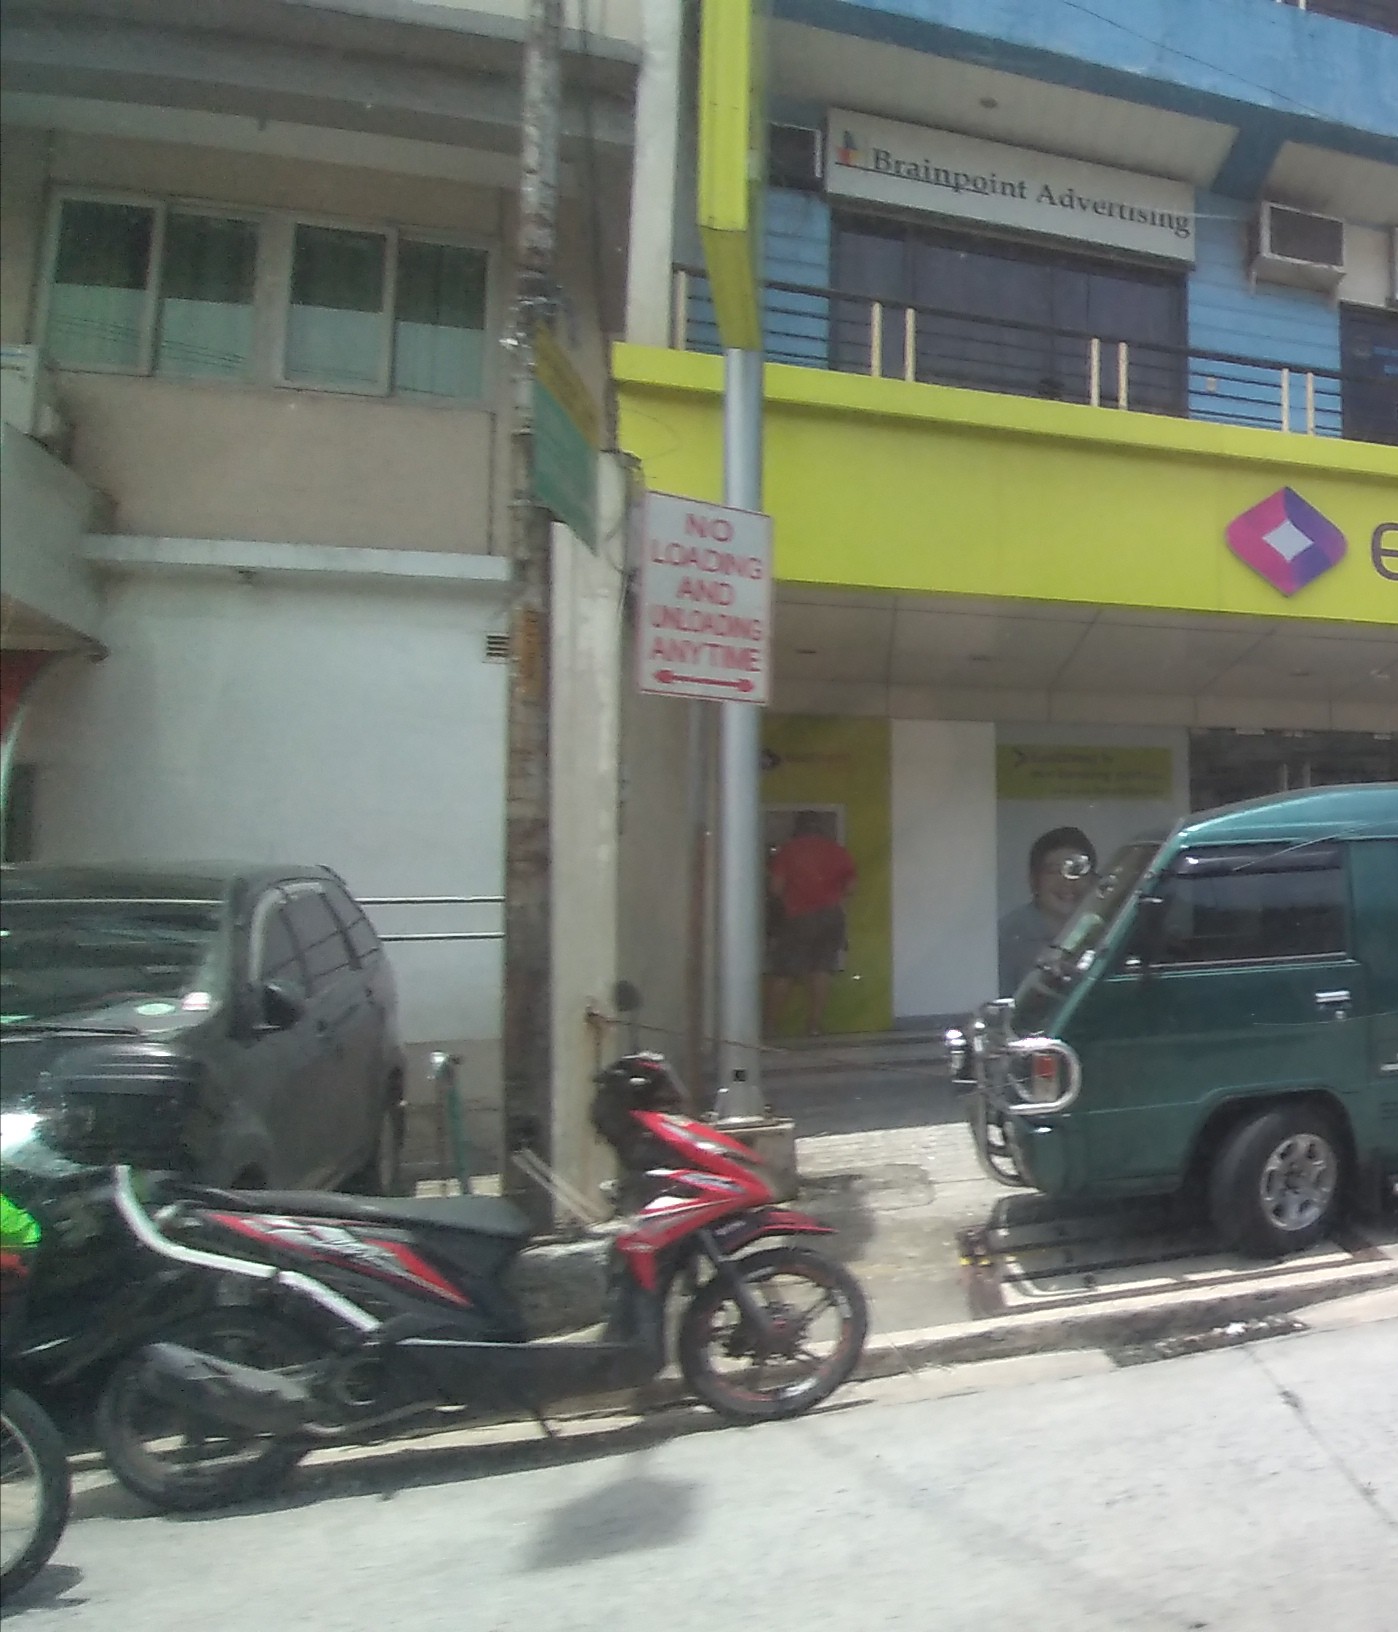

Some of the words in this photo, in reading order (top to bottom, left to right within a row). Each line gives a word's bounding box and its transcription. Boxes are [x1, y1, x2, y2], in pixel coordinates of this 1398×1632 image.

[872, 147, 1028, 200] Brainpoint
[1036, 183, 1191, 239] Advertising
[686, 513, 735, 542] NO
[651, 539, 763, 581] LOADING
[676, 575, 737, 607] AND
[651, 605, 763, 641] UNLOADING
[649, 638, 762, 673] ANYTIME
